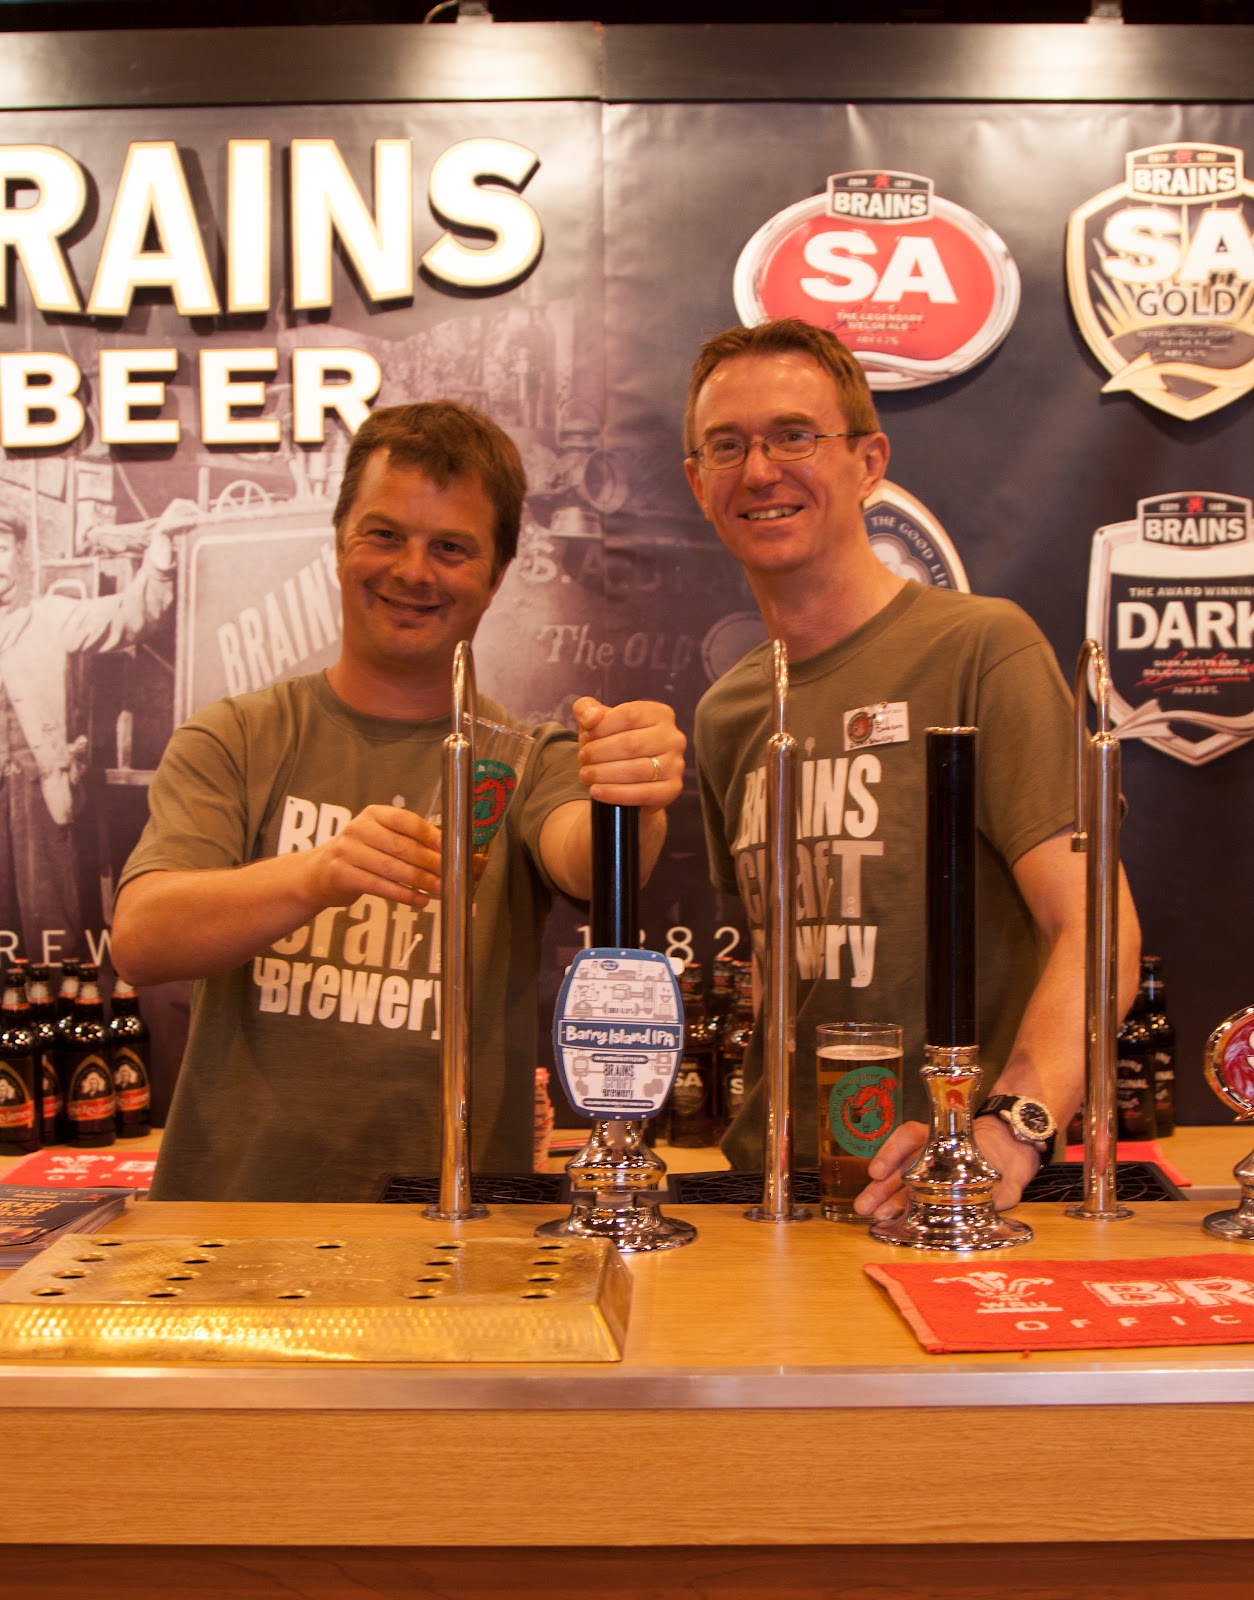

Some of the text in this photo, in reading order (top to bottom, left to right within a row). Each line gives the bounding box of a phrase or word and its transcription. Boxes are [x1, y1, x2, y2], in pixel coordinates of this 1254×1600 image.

[1134, 167, 1235, 195] BRAINS
[834, 192, 928, 218] BRAINS
[1102, 206, 1254, 283] SA
[800, 231, 958, 303] SA
[1137, 290, 1235, 316] GOLD
[0, 347, 382, 447] BEER
[1145, 517, 1245, 544] BRAINS
[870, 516, 949, 587] THE GOOD LIF
[1129, 586, 1254, 597] THE AWARD WINNIN
[1117, 601, 1254, 650] DARK
[537, 623, 615, 670] The
[735, 753, 882, 850] BRINS
[577, 925, 740, 963] 182
[566, 1025, 676, 1047] Barry Island IPA
[859, 1072, 881, 1081] Beer
[845, 1138, 865, 1153] Cider
[1015, 1314, 1242, 1332] OFFIC
